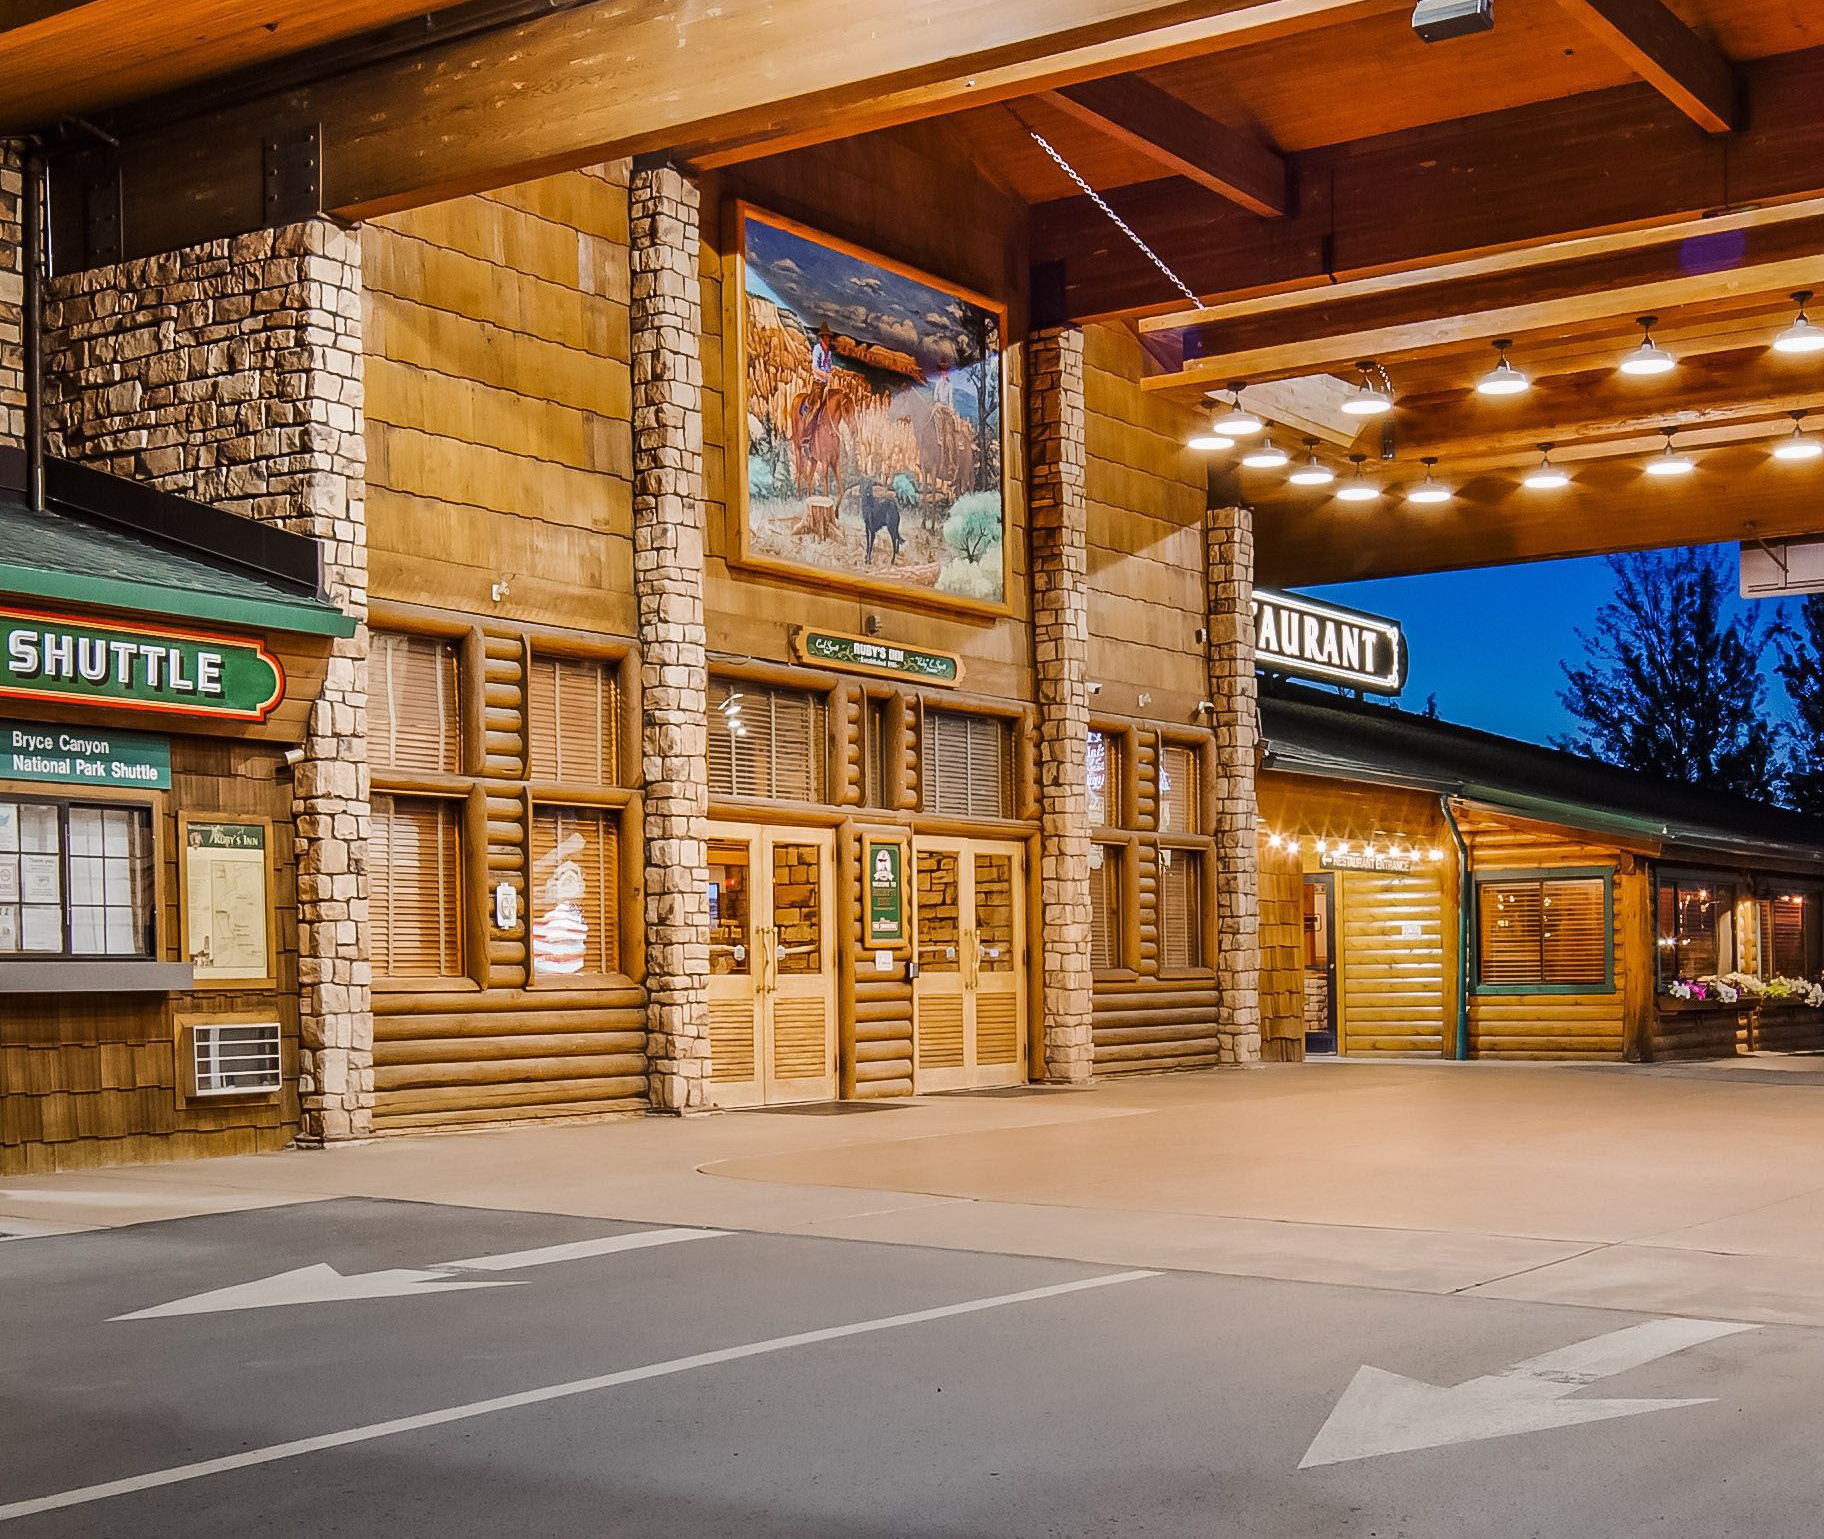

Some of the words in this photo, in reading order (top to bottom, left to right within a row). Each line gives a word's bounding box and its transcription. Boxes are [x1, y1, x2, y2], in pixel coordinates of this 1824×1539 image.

[1250, 601, 1376, 673] AURANT
[8, 629, 223, 695] SHUTTLE
[12, 730, 53, 750] Bryce
[59, 734, 109, 756] Canyon
[13, 755, 70, 774] National
[76, 759, 106, 777] Park
[111, 762, 158, 780] Shuttle
[243, 835, 258, 845] INN
[1333, 855, 1374, 869] RESTAURANT
